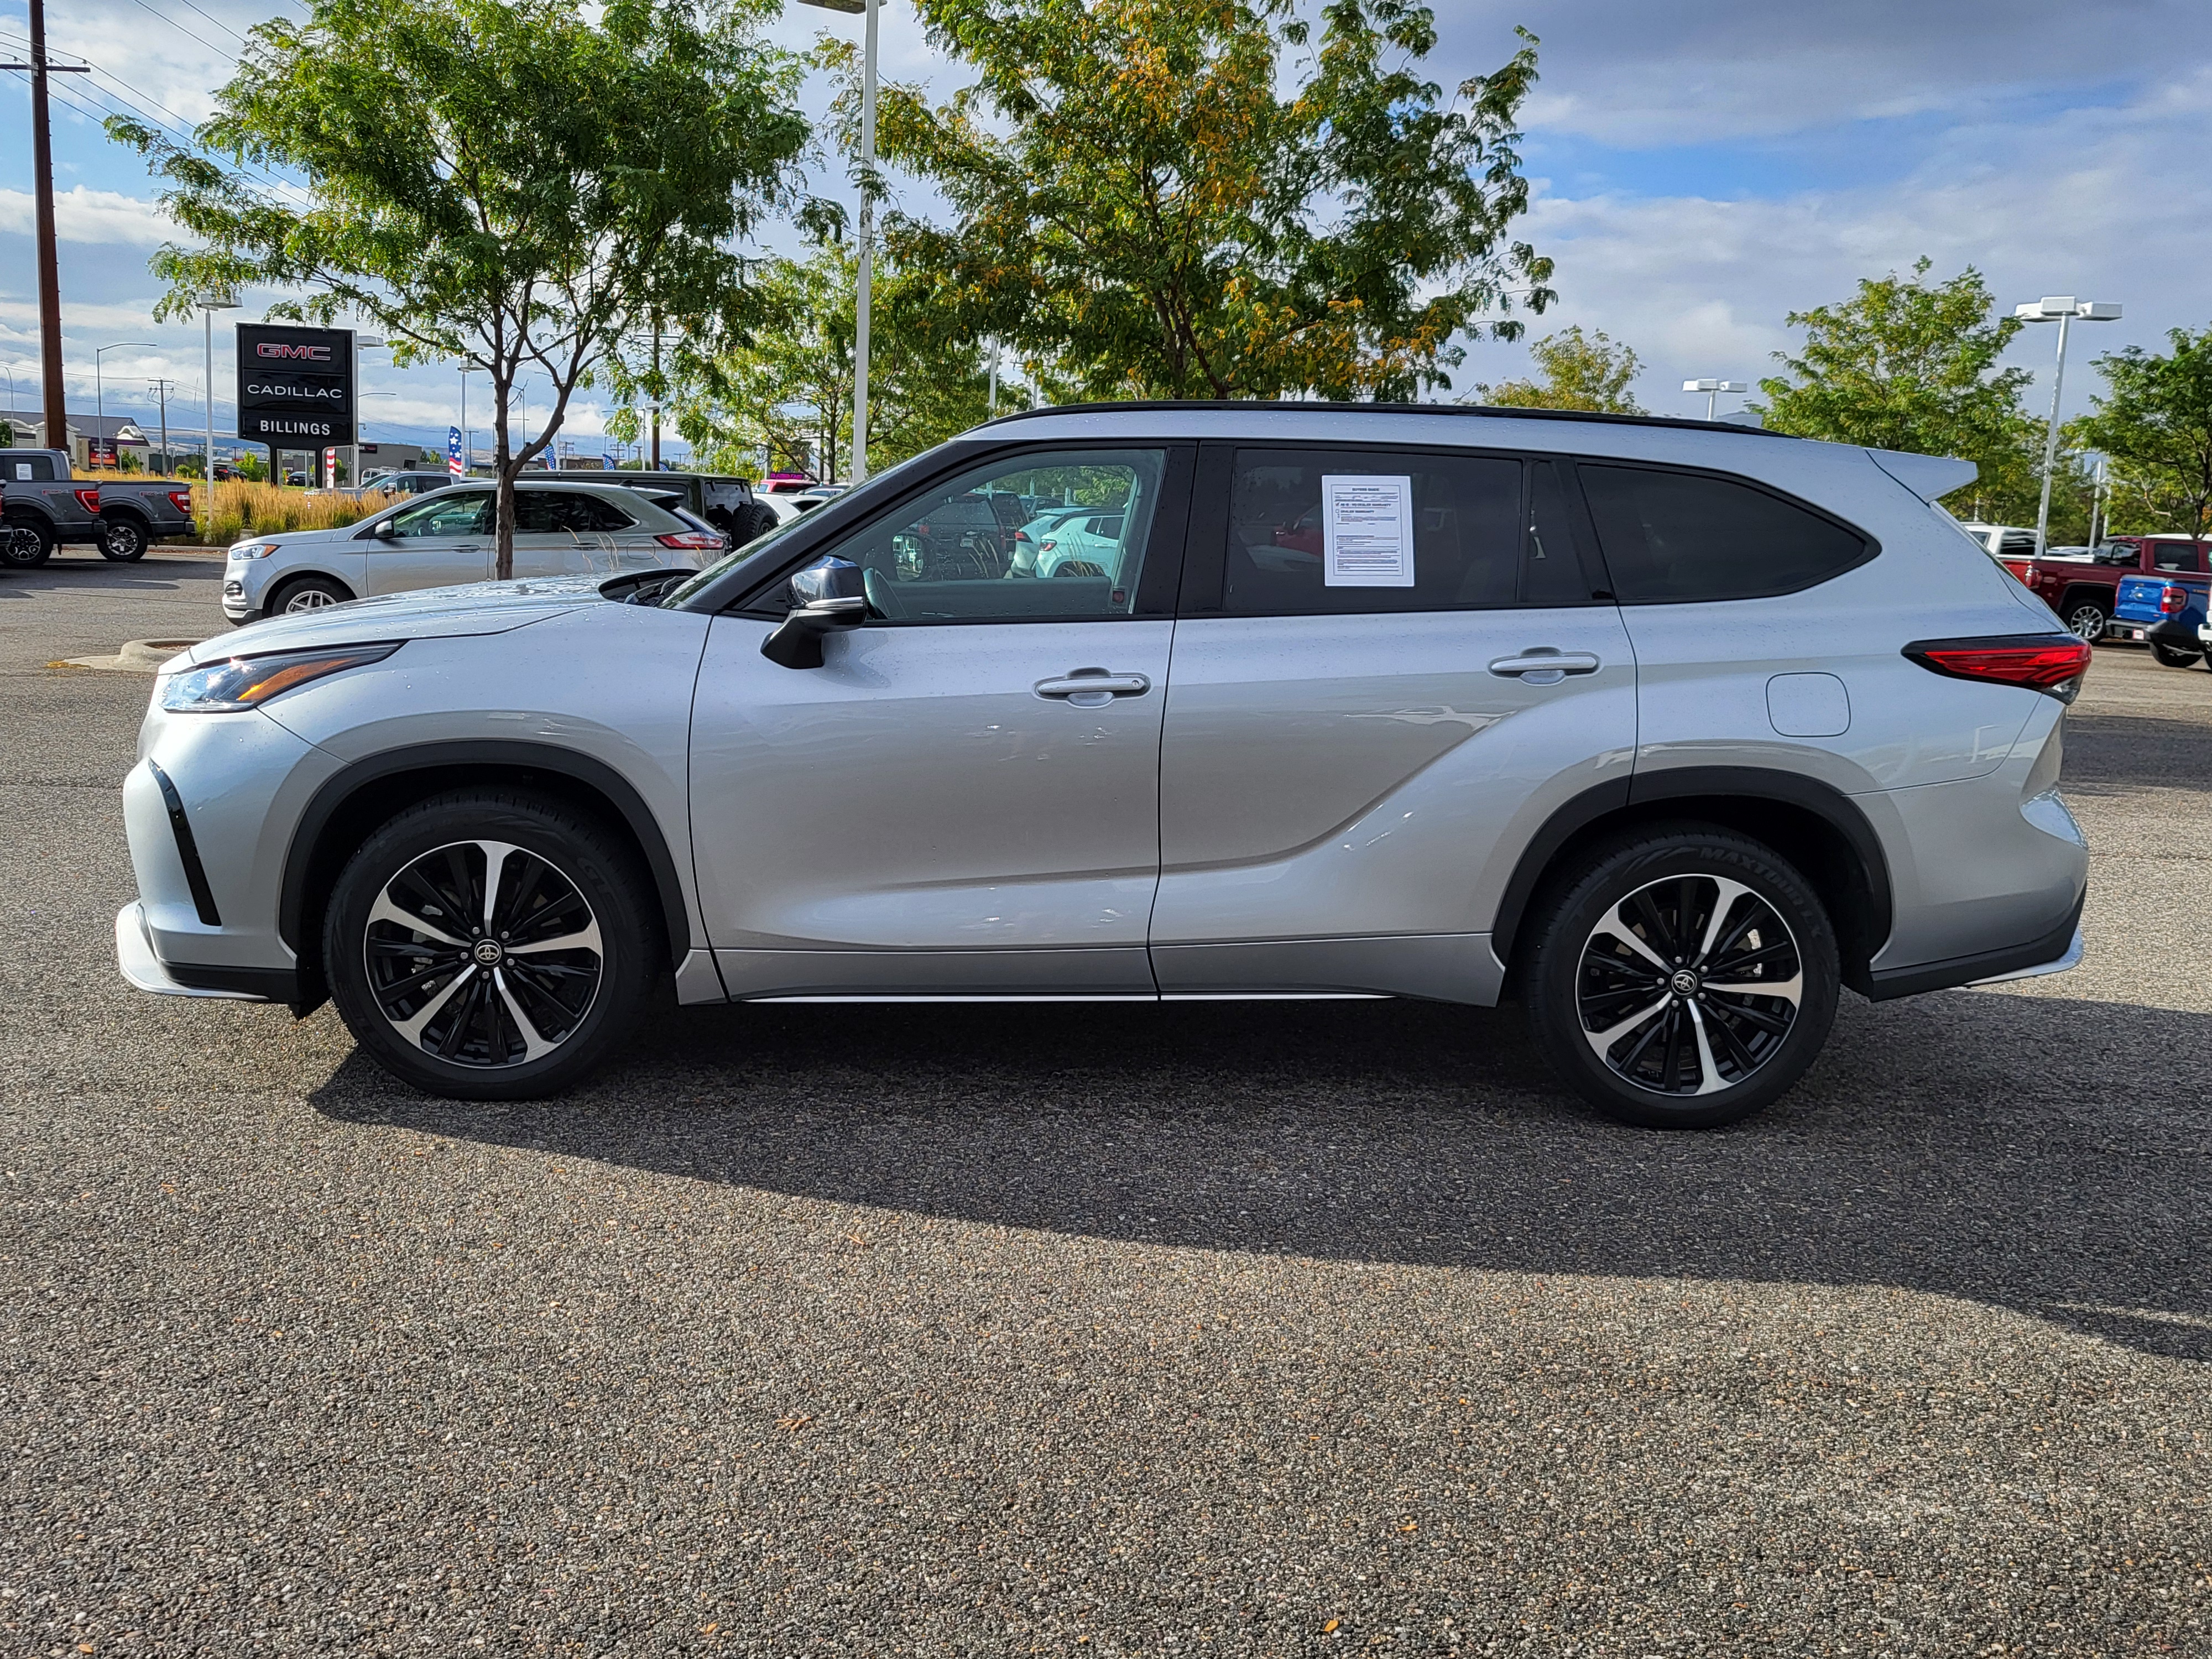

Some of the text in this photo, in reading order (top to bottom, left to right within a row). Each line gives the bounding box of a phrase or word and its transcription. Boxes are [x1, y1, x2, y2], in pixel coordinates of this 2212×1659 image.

[257, 343, 331, 361] GMC
[247, 384, 342, 398] CADILLAC
[260, 420, 331, 435] BILLINGS
